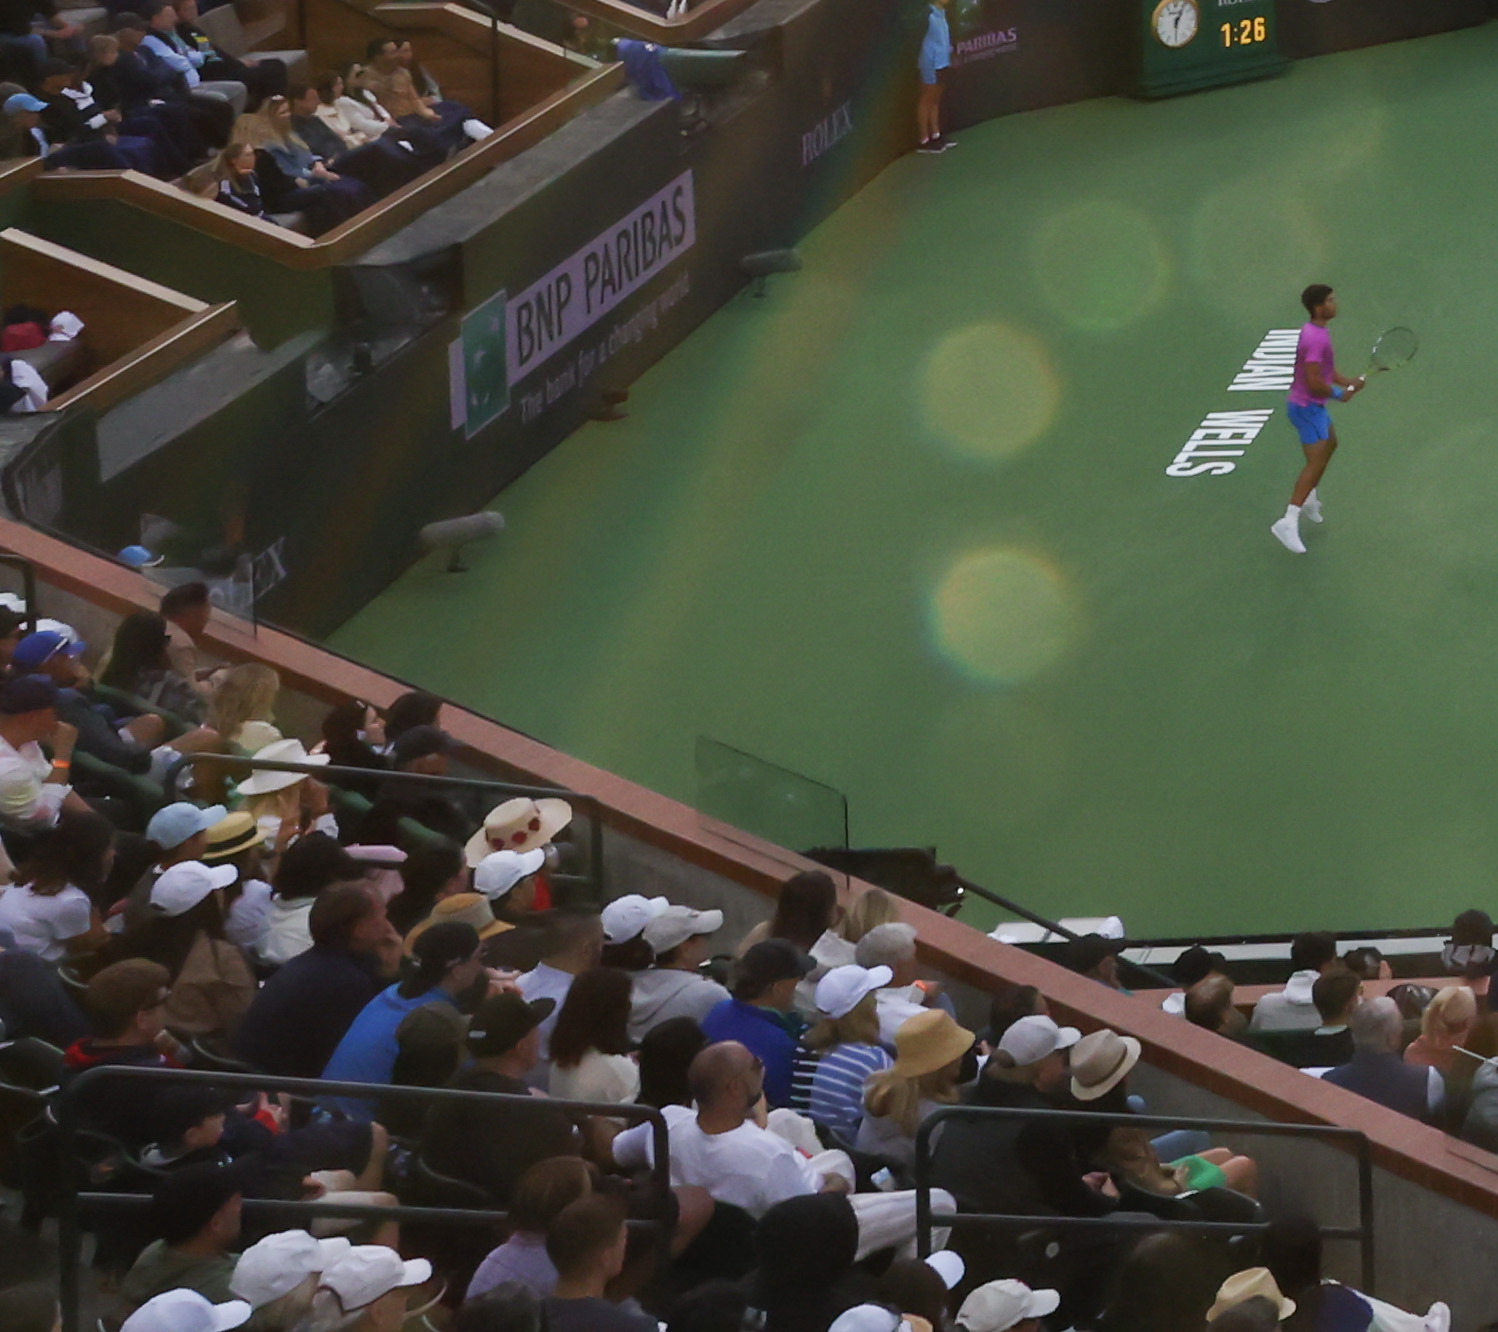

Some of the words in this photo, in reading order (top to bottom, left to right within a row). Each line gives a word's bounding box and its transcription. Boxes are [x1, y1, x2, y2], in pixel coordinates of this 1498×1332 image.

[956, 28, 1018, 55] PARIBAS
[1220, 17, 1266, 47] 1:26
[516, 272, 572, 366] BNP
[583, 184, 687, 314] PARIBAS
[1165, 408, 1274, 477] WELLS
